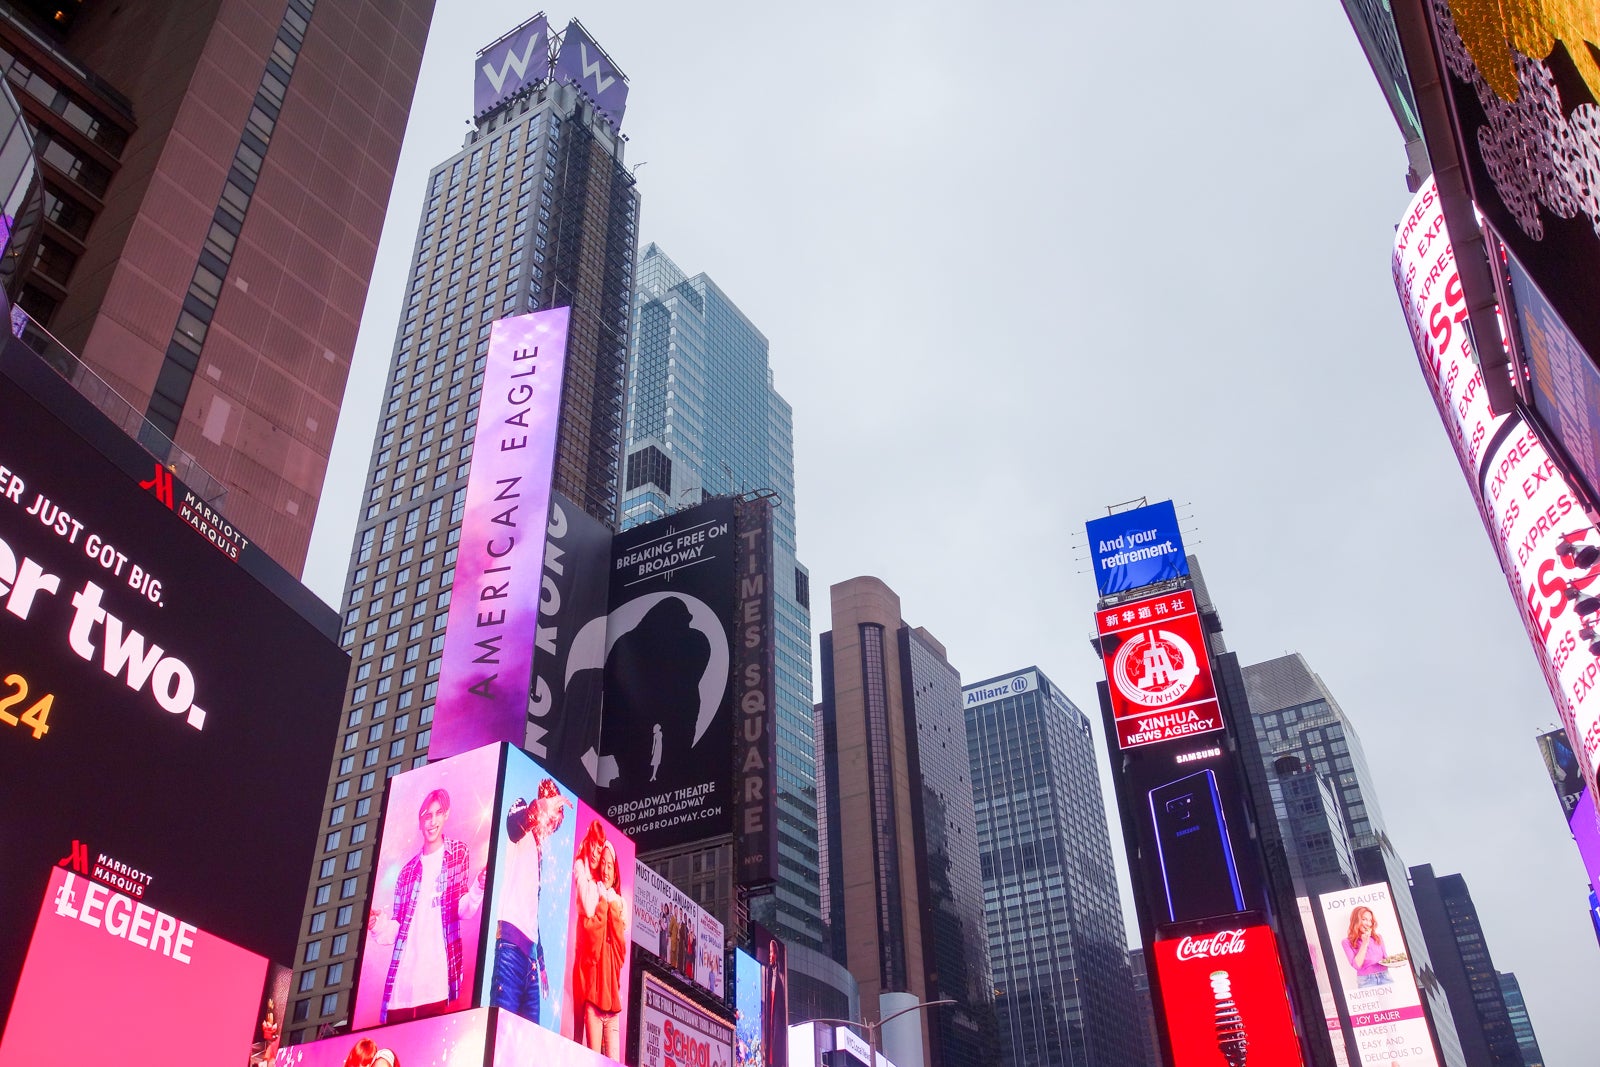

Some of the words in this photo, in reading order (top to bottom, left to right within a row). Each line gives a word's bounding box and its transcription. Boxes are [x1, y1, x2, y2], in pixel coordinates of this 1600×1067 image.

[482, 32, 539, 94] W
[581, 41, 616, 94] W
[181, 506, 238, 559] MARQUIS
[185, 491, 249, 549] MARRIOTT
[468, 475, 522, 700] AMERICAN
[500, 346, 538, 452] EAGLE
[26, 494, 84, 544] JUST
[85, 534, 128, 576] GOT
[128, 564, 164, 608] BIG.
[616, 542, 673, 570] BREAKING
[677, 530, 705, 550] FREE
[708, 523, 728, 539] ON
[1099, 538, 1124, 554] And
[1127, 528, 1157, 548] your
[1101, 540, 1178, 570] retirement.
[638, 544, 704, 576] BROADWAY
[742, 528, 764, 648] TIMES
[1106, 599, 1185, 626] 新华通讯社
[69, 580, 206, 731] two.
[967, 685, 1009, 704] Allianz
[1140, 684, 1187, 703] XINHUA
[1127, 729, 1164, 744] NEWS
[1164, 718, 1214, 737] AGENCY
[1138, 710, 1199, 732] XINHUA
[742, 664, 766, 834] SQUARE
[1176, 748, 1221, 764] SAMSUNG
[617, 792, 672, 815] BROADWAY
[674, 782, 716, 800] THEATRE
[617, 812, 636, 825] 53RD
[638, 810, 654, 821] AND
[658, 796, 706, 816] BROADWAY
[622, 806, 722, 836] KONGBROADWAY.COM
[98, 854, 152, 886] MARRIOTT
[744, 854, 763, 865] NYC
[94, 866, 144, 896] MARQUIS
[636, 862, 650, 883] MUST
[651, 874, 671, 899] CLOTHES
[673, 890, 693, 916] JANUARY
[693, 906, 696, 918] 6
[1327, 900, 1346, 910] JOY
[1350, 892, 1386, 906] BAUER
[1176, 928, 1246, 961] Coca-Cola
[1350, 987, 1392, 1000] NUTRITION
[1352, 1002, 1380, 1012] EXPERT
[1356, 1014, 1372, 1024] JOY
[1374, 1010, 1400, 1022] BAUER
[1359, 1026, 1388, 1037] MAKES
[1390, 1024, 1398, 1032] IT
[1362, 1039, 1382, 1050] EASY
[1386, 1036, 1404, 1046] AND
[1364, 1050, 1410, 1063] DELICIOUS
[1412, 1047, 1423, 1056] TO
